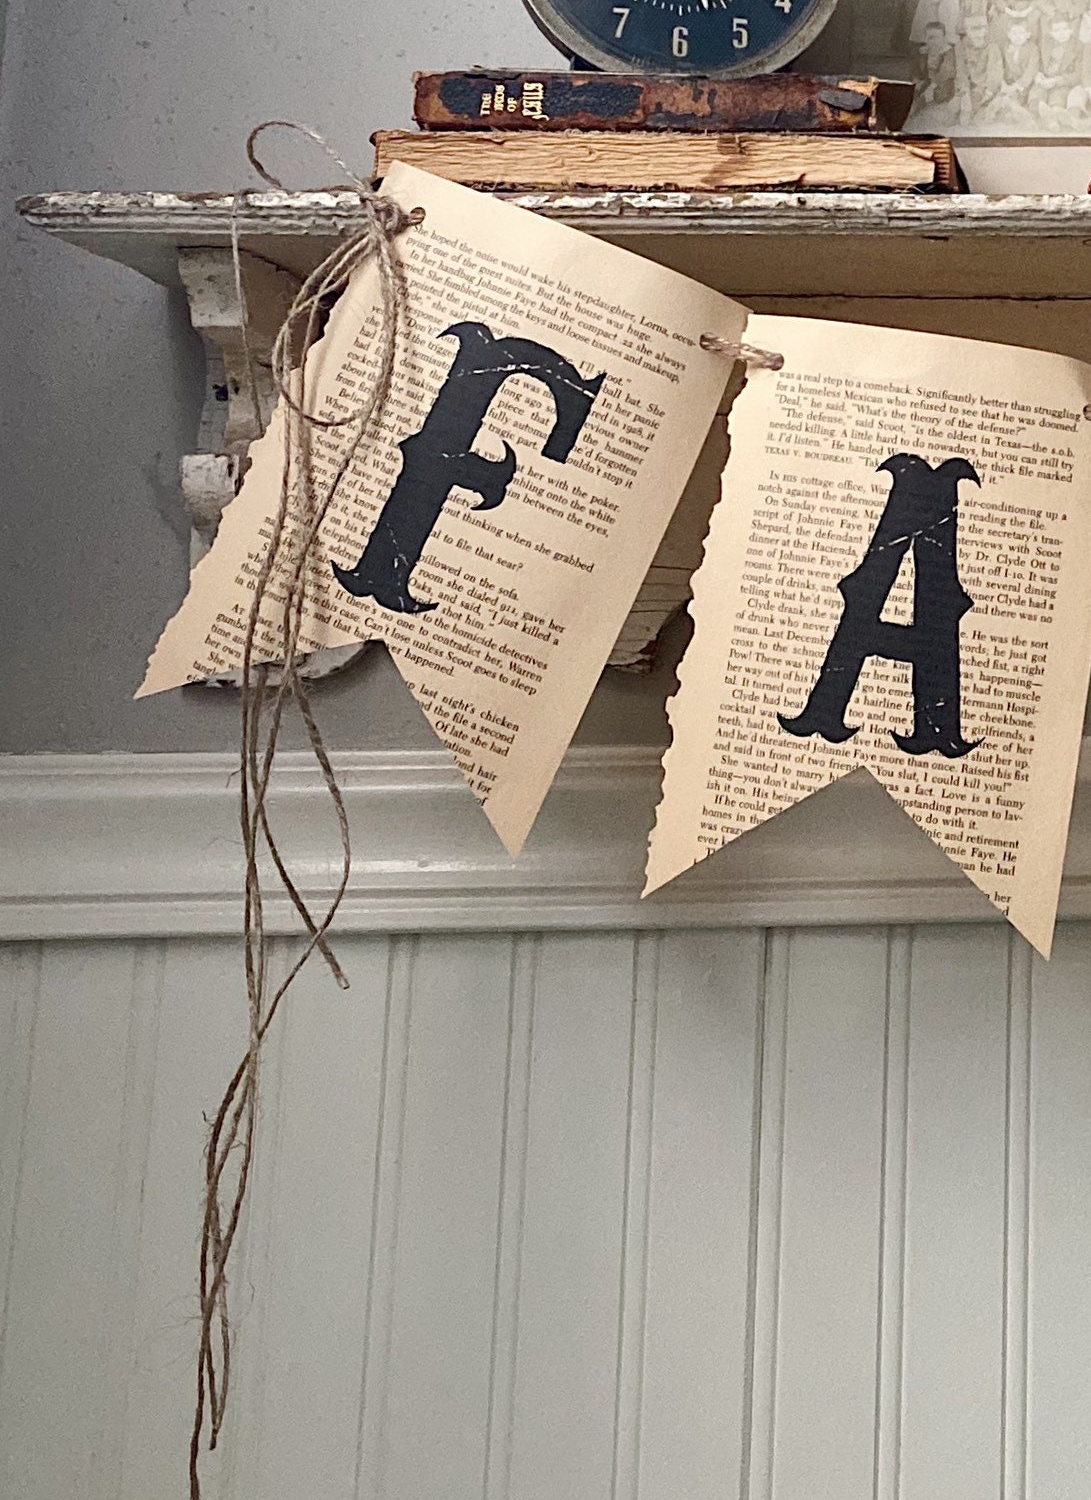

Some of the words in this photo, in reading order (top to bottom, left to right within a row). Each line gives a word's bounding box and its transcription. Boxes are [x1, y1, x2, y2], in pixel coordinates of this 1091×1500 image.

[612, 7, 630, 38] 7
[672, 26, 688, 57] 6
[732, 18, 748, 49] 5
[405, 236, 433, 253] pying
[432, 247, 450, 258] one
[450, 253, 463, 263] of
[462, 257, 478, 270] the
[478, 266, 504, 281] guest
[535, 286, 555, 301] But
[556, 294, 573, 309] the
[574, 301, 604, 321] house
[606, 317, 625, 330] was
[626, 323, 653, 344] huge.
[412, 221, 429, 237] She
[430, 229, 459, 249] hoped
[458, 242, 474, 254] the
[475, 250, 499, 264] noise
[501, 260, 530, 277] would
[530, 272, 555, 287] wake
[556, 280, 571, 295] his
[573, 290, 637, 324] stepdaughter,
[638, 314, 670, 338] Lorna,
[671, 332, 697, 347] occu-
[803, 373, 821, 383] real
[823, 376, 843, 388] step
[844, 378, 854, 387] to
[915, 386, 978, 406] Significantly
[979, 394, 1009, 409] better
[1010, 400, 1032, 413] than
[1033, 405, 1082, 423] struggling
[330, 321, 607, 614] F
[764, 445, 791, 456] TEXAS
[526, 466, 545, 481] her
[547, 477, 569, 492] with
[571, 485, 588, 499] the
[589, 495, 620, 513] poker.
[777, 453, 985, 758] A
[419, 683, 439, 700] last
[441, 696, 476, 715] night's
[479, 710, 520, 732] chicken
[716, 727, 736, 739] And
[736, 729, 758, 743] he'd
[758, 733, 811, 752] threatened
[812, 742, 851, 758] Johnnie
[852, 748, 877, 763] Faye
[878, 755, 905, 766] more
[907, 756, 930, 769] than
[931, 762, 958, 773] once.
[960, 762, 995, 778] Raised
[996, 767, 1012, 780] his
[1013, 769, 1030, 783] fist
